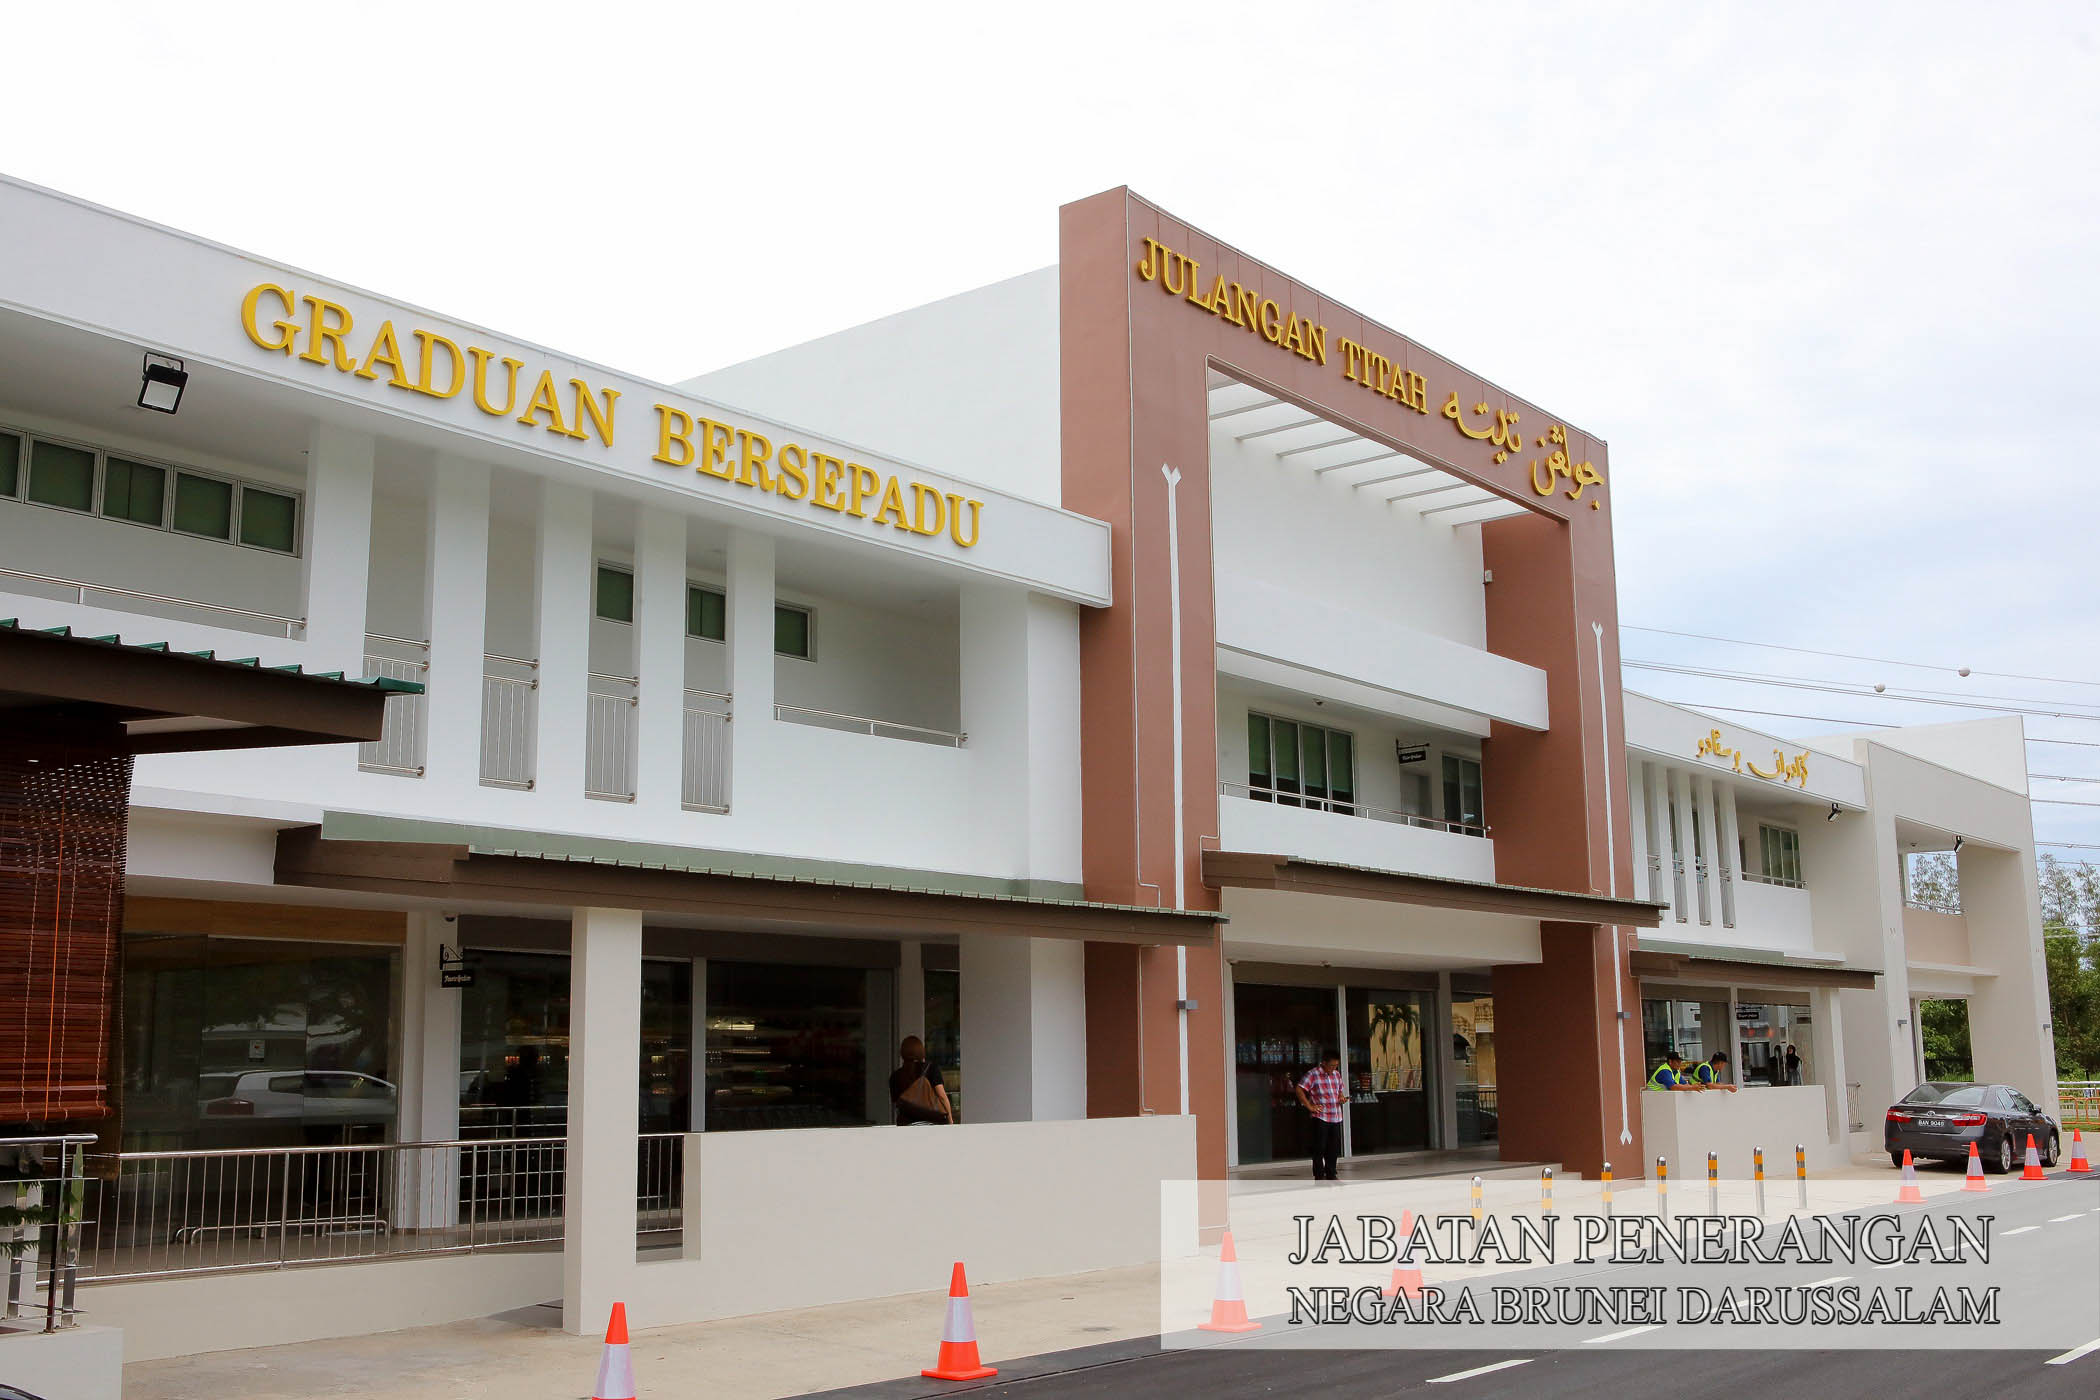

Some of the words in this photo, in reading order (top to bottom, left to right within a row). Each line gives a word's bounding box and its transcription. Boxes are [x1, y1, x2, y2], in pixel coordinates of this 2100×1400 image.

[241, 283, 621, 448] GRADUAN
[652, 403, 984, 548] BERSEPADU
[1137, 236, 1328, 366] JULANGAN
[1336, 336, 1430, 415] TITAH
